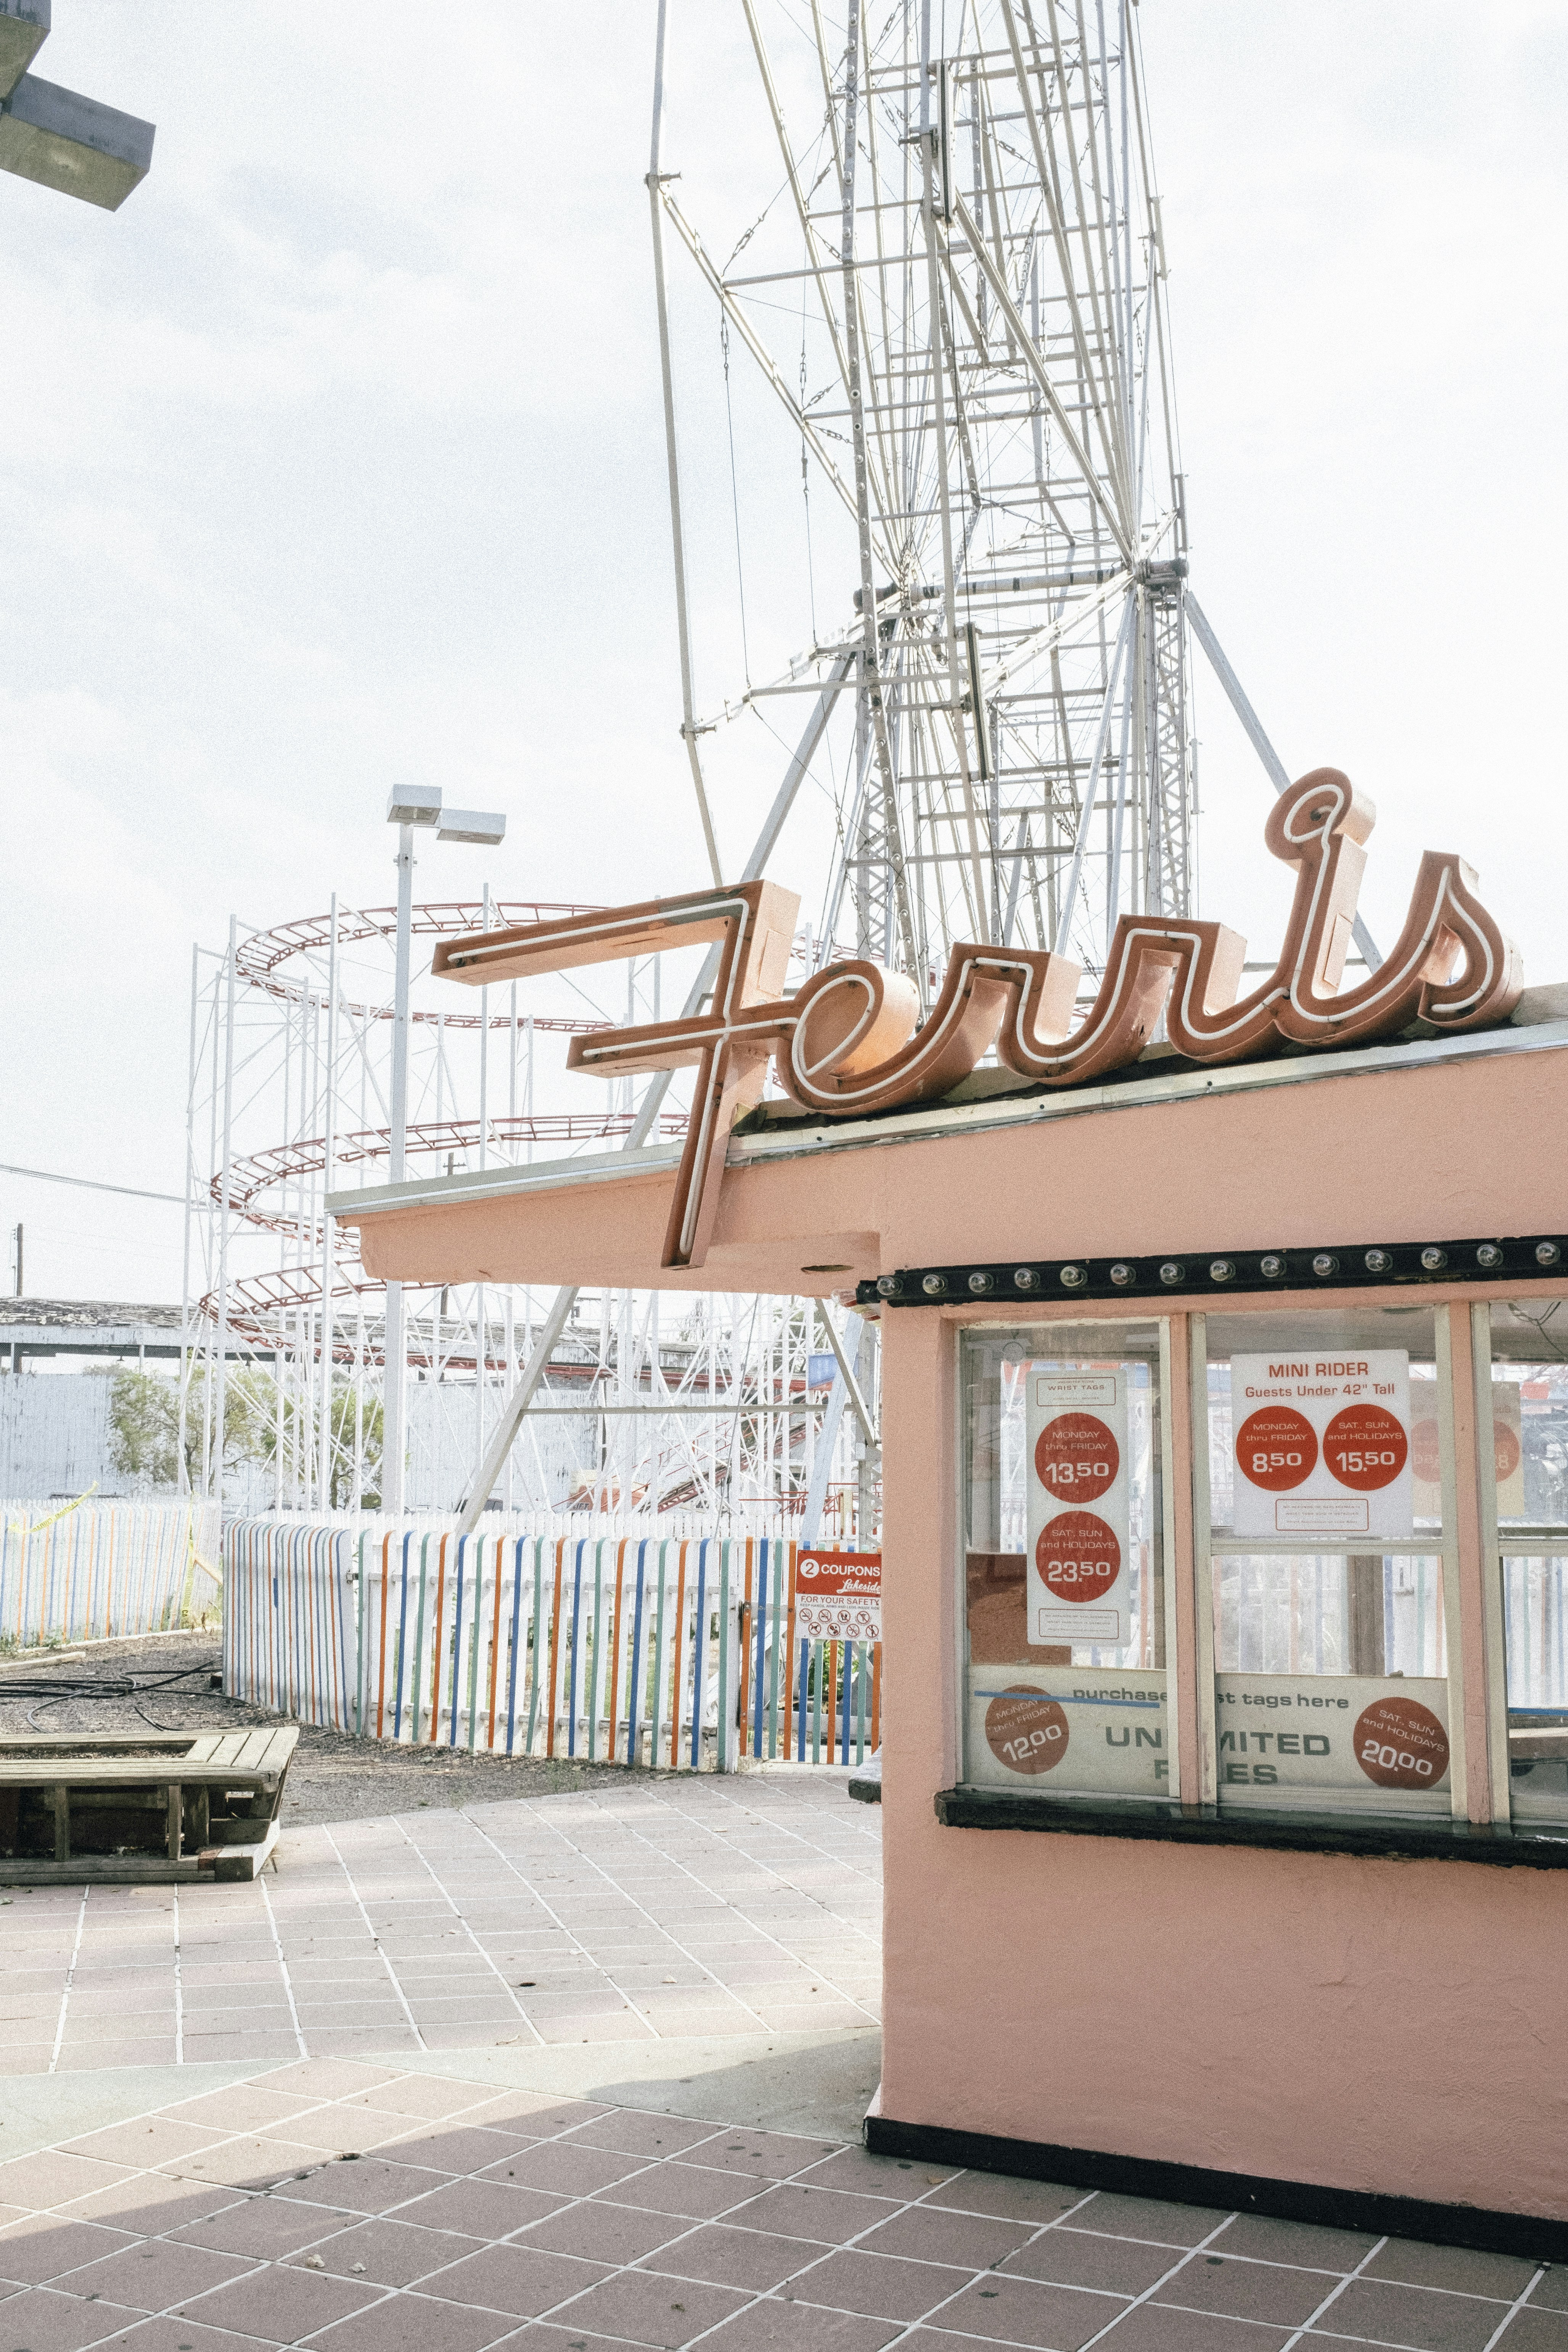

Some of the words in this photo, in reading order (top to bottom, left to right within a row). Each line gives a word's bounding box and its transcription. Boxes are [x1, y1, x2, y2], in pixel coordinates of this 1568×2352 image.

[431, 767, 1523, 1268] Ferris
[1269, 1364, 1309, 1378] MINI
[1315, 1362, 1369, 1377] RIDER
[1245, 1386, 1292, 1398] Guests
[1297, 1385, 1338, 1396] Under
[1343, 1384, 1368, 1395] 42"
[1373, 1383, 1394, 1395] Tall
[1053, 1431, 1099, 1439] MONDAY
[1253, 1452, 1301, 1473] 8.50
[1336, 1451, 1395, 1472] 15.50
[1045, 1462, 1109, 1484] 13.50
[805, 1562, 814, 1575] 2
[821, 1564, 881, 1577] COUPONS
[1048, 1561, 1111, 1583] 23.50
[836, 1578, 881, 1594] Lakeside
[820, 1596, 844, 1604] YOUR
[1073, 1687, 1168, 1702] purchase
[1243, 1694, 1291, 1708] tags
[1298, 1693, 1349, 1708] here
[994, 1721, 1015, 1733] thru
[1016, 1705, 1051, 1724] FRIDAY
[995, 1700, 1039, 1719] MONDAY
[1362, 1717, 1384, 1729] and
[1387, 1725, 1445, 1752] HOLIDAYS
[1408, 1720, 1435, 1736] SUN
[1002, 1724, 1063, 1762] 12.00
[1361, 1739, 1433, 1776] 20.00
